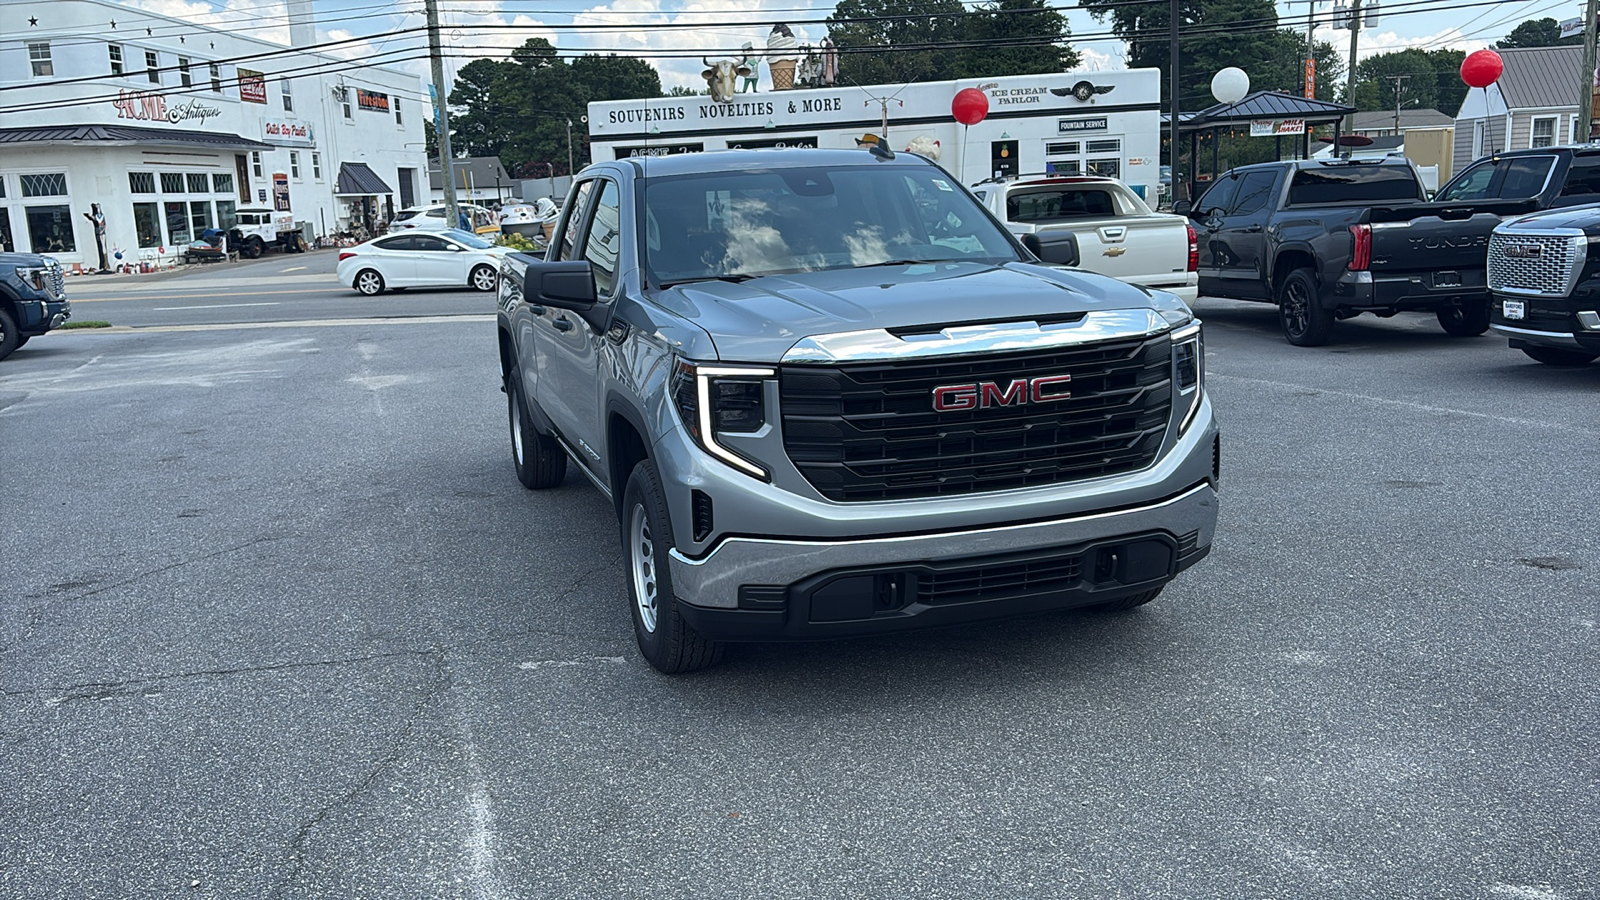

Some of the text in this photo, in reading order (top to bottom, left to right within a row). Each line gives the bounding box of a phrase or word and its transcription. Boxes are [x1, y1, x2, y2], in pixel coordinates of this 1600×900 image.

[991, 87, 1048, 98] ICE CREAM
[113, 88, 169, 122] ACME
[998, 96, 1041, 105] PARLOR
[609, 98, 841, 124] SOUVENIRS NOVELTIES & MORE
[266, 123, 306, 138] Dutch Boy Paints
[1060, 119, 1106, 130] FOUNTAIN SERVICE
[278, 199, 289, 209] TEA
[1408, 236, 1487, 251] TUNDR
[1503, 244, 1540, 258] GMC
[932, 374, 1071, 413] GMC
